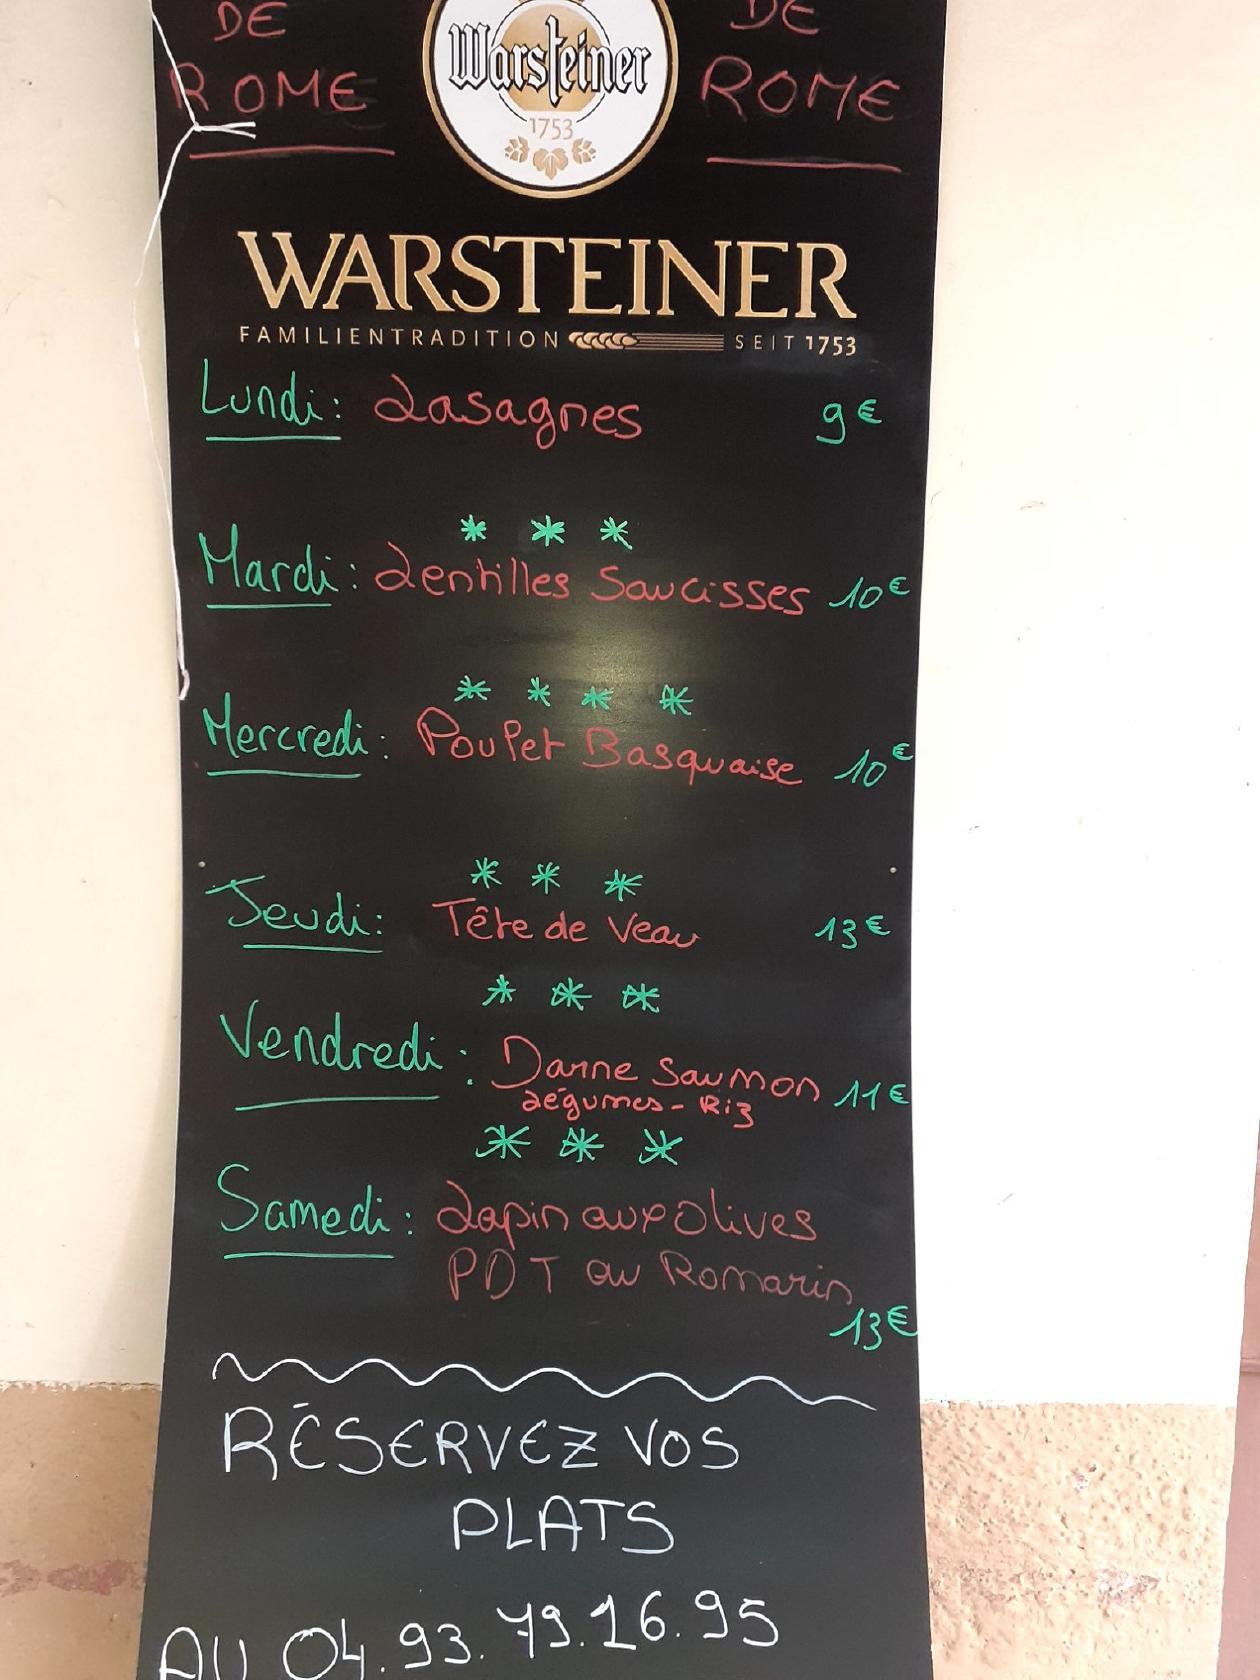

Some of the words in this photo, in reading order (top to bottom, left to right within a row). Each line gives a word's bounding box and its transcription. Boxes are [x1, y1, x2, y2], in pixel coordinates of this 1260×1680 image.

[213, 0, 288, 43] DE
[169, 61, 368, 113] ROME
[447, 14, 652, 108] Warsteiner
[701, 55, 901, 123] ROME
[529, 117, 575, 140] 1753
[237, 230, 858, 321] WARSTEINER
[239, 325, 559, 349] FAMILIENTRADITION
[735, 334, 795, 351] SEIT
[804, 335, 858, 357] 1753
[373, 373, 643, 451] Lasagnes
[374, 550, 571, 601] Lentilles
[587, 564, 811, 617] Saucisses
[828, 574, 911, 612] 10€
[415, 704, 566, 762] Poulet
[581, 728, 803, 787] Basquaise
[833, 742, 914, 790] 10€
[430, 896, 534, 941] Tête
[543, 911, 589, 943] de
[814, 914, 891, 951] 13€
[491, 1035, 639, 1089] Darne
[651, 1056, 821, 1102] Saumon
[435, 1179, 571, 1252] Lapin
[447, 1248, 555, 1303] PDT
[585, 1259, 642, 1289] au
[659, 1250, 854, 1306] Romarin
[829, 1304, 920, 1352] 13€
[623, 1416, 742, 1471] VOS
[452, 1494, 676, 1555] PLATS
[158, 1626, 248, 1680] AU
